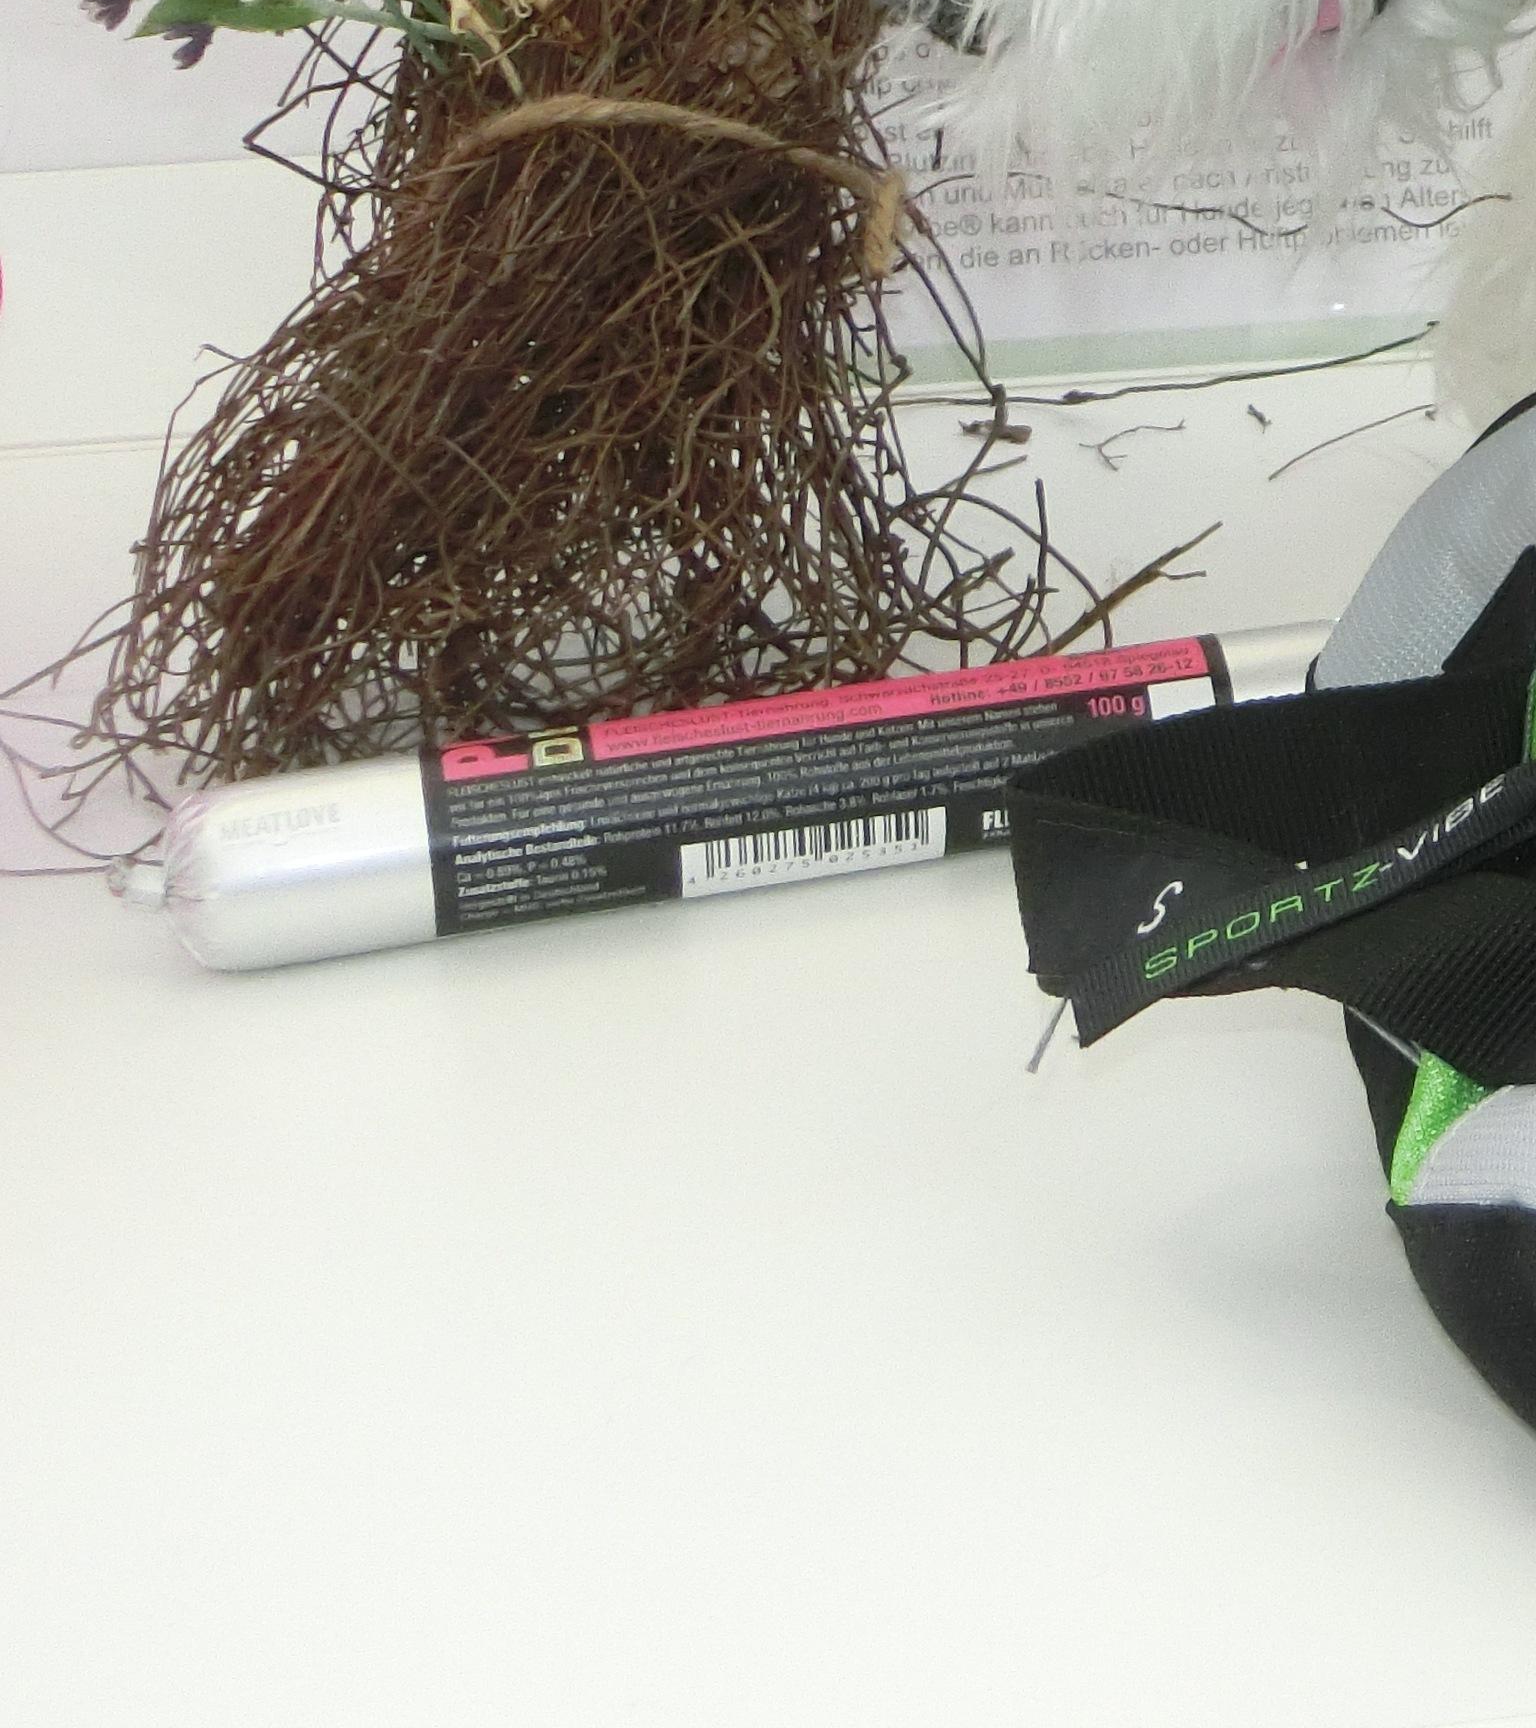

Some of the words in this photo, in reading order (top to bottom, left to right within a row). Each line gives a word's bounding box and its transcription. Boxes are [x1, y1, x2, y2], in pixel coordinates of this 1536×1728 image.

[1168, 228, 1228, 255] oder
[1087, 692, 1125, 719] 100
[1131, 694, 1146, 717] g
[1143, 773, 1506, 981] SPORTZ-VIBE
